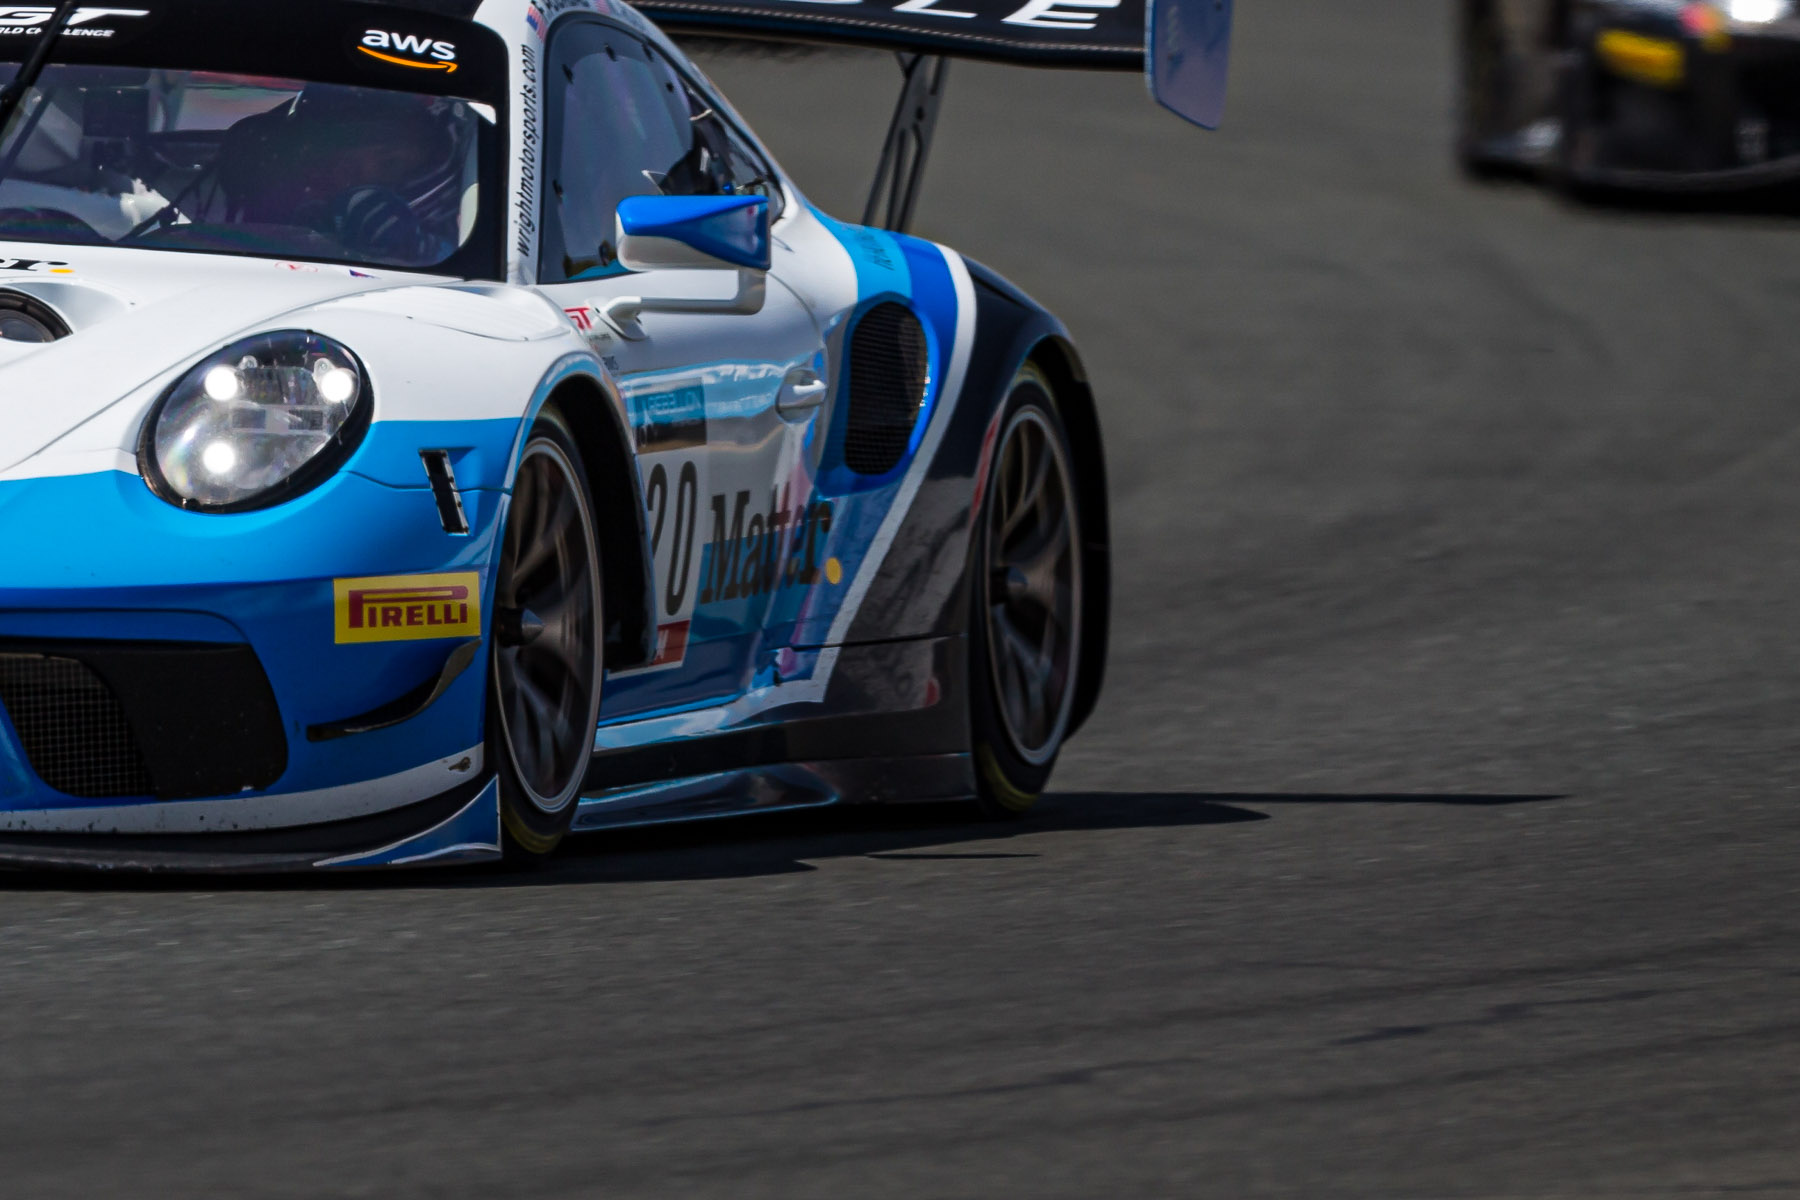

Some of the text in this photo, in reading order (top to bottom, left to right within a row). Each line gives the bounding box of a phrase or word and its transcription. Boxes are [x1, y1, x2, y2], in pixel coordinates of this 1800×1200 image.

[26, 26, 116, 37] CHLENGE
[362, 29, 456, 60] aws
[514, 44, 540, 258] wrightmotorsports.com
[348, 585, 469, 629] PIRELLI
